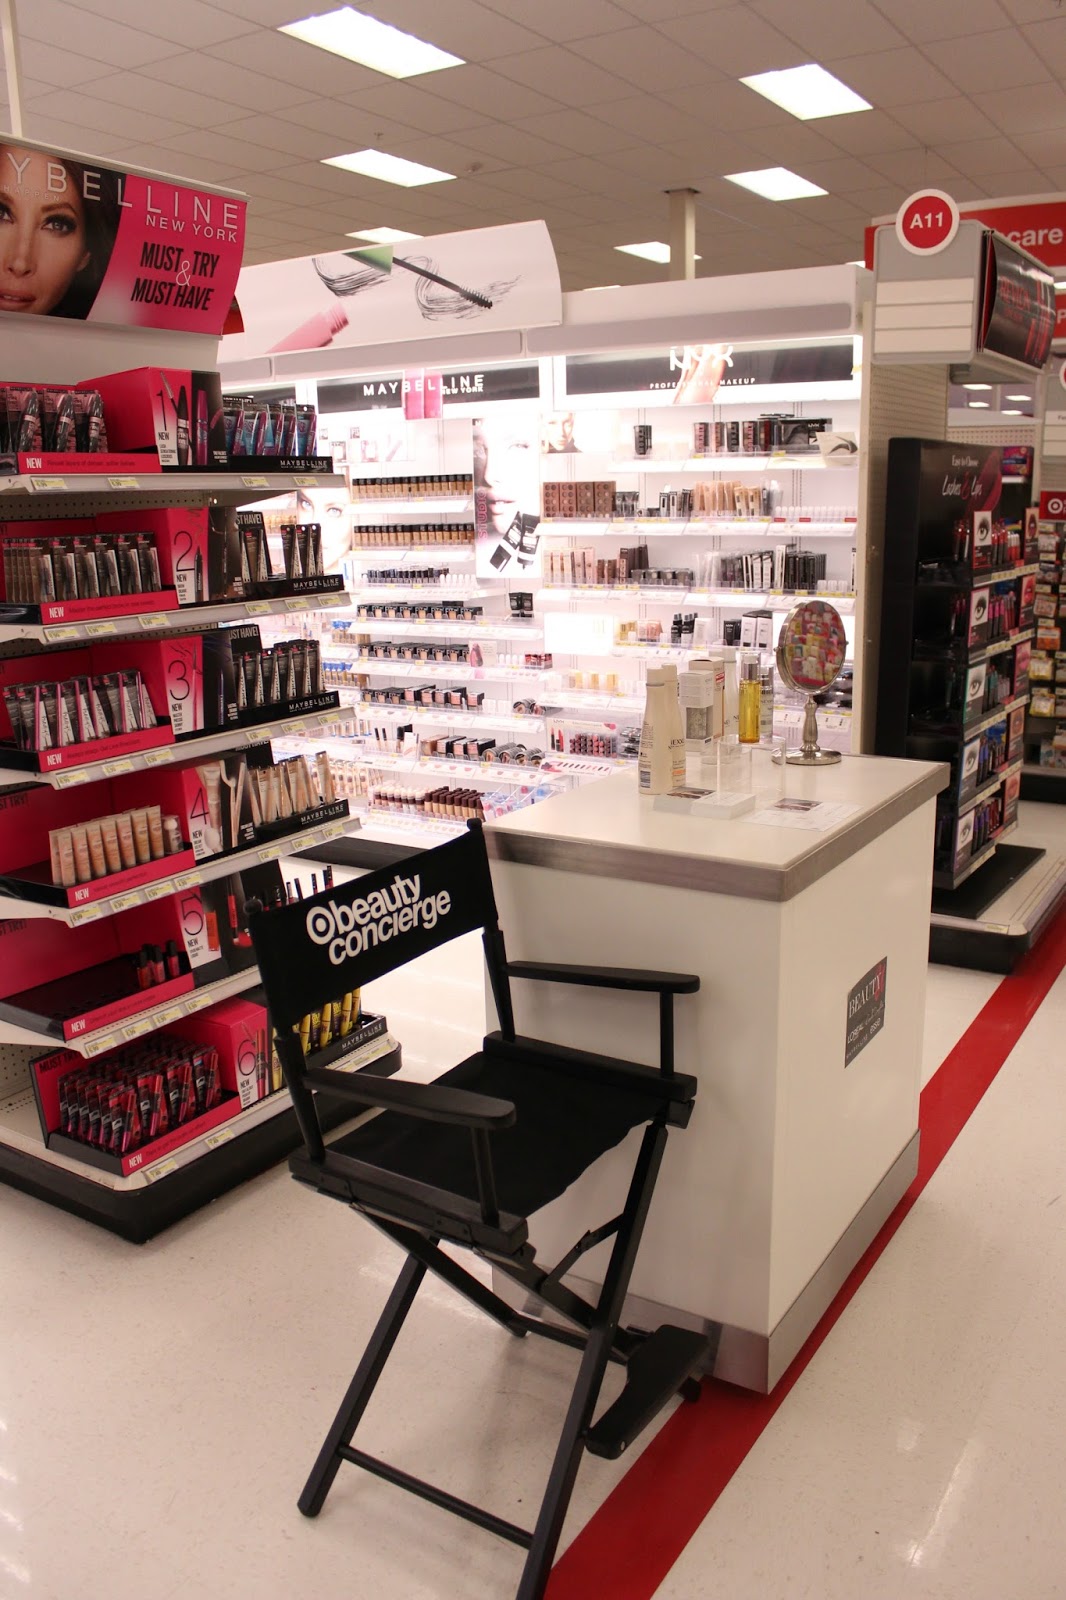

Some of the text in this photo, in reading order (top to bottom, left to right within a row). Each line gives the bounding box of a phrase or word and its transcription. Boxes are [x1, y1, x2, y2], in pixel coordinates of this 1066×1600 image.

[3, 185, 59, 202] HAPPEN
[146, 214, 237, 242] NEW YORK
[909, 212, 944, 229] A11
[1000, 228, 1064, 246] care
[140, 241, 220, 278] MUST TRY
[176, 260, 191, 286] &
[130, 277, 215, 311] MUST HAVE
[363, 374, 485, 397] MAYBELLINE
[460, 385, 484, 394] YORK
[719, 377, 756, 386] MAKEUP
[158, 432, 169, 440] NEW
[26, 458, 42, 469] NEW
[243, 513, 262, 525] HAVE!
[477, 488, 488, 540] STUDIO
[174, 530, 195, 572] 2
[176, 574, 187, 582] NEW
[293, 577, 340, 589] MAYBELLINE
[49, 606, 64, 618] NEW
[240, 626, 260, 639] HAVE!
[168, 659, 190, 701] 3
[172, 703, 182, 712] NEW
[288, 695, 335, 710] MAYBELLINE
[47, 753, 62, 766] NEW
[190, 787, 210, 825] 4
[300, 803, 344, 822] MAYBELLINE
[192, 829, 202, 839] NEW
[75, 888, 89, 901] NEW
[329, 874, 420, 935] beauty
[181, 893, 204, 936] 5
[328, 890, 451, 965] concierge
[187, 938, 198, 948] NEW
[848, 972, 882, 1019] BEAUTY
[71, 1019, 86, 1033] NEW
[341, 1023, 383, 1049] MAYBELLINE
[237, 1039, 256, 1076] 6
[240, 1079, 250, 1089] NEW
[128, 1153, 143, 1168] NEW
